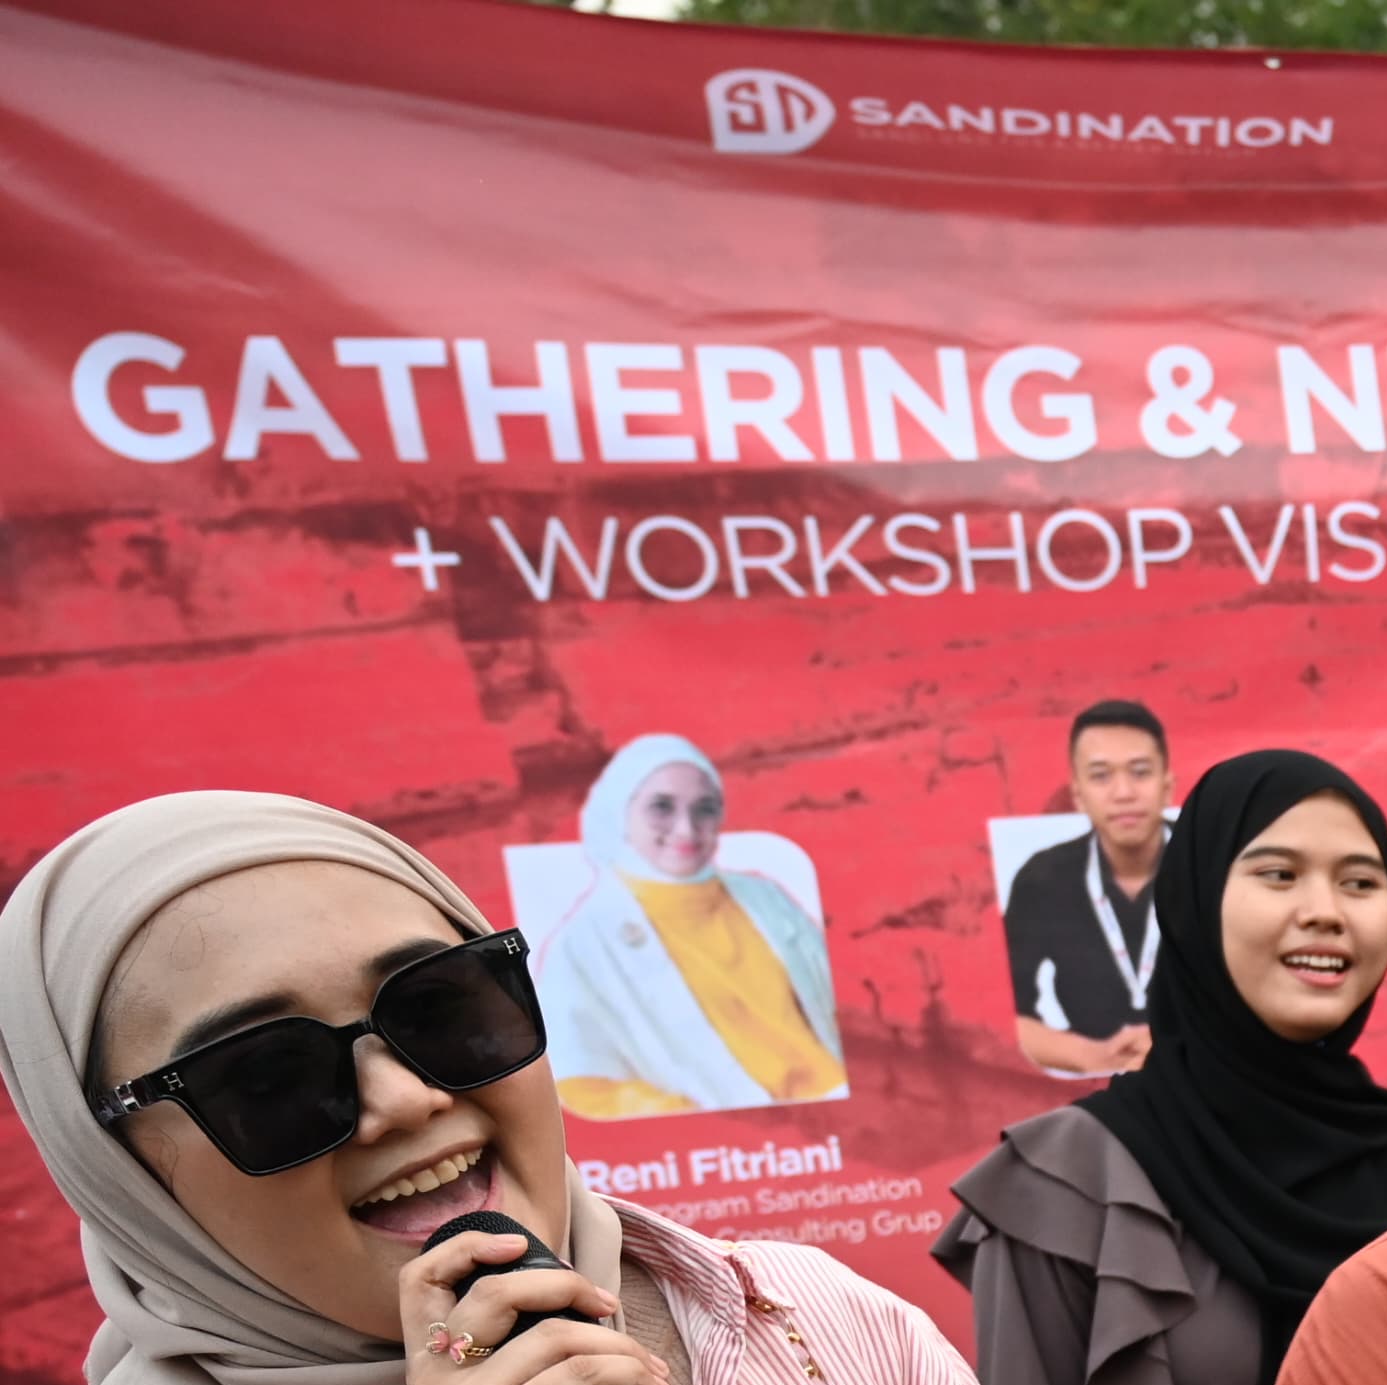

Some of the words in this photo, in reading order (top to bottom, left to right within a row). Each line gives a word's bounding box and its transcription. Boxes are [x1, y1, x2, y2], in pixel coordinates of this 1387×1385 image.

[850, 98, 1334, 147] SANDINATION
[72, 331, 1099, 463] GATHERING
[1139, 345, 1244, 460] &
[490, 507, 1193, 601] WORKSHOP
[580, 1151, 680, 1195] Reni
[690, 1135, 843, 1187] Fitriani
[756, 1174, 923, 1215] Sandination
[871, 1207, 943, 1239] Grup
